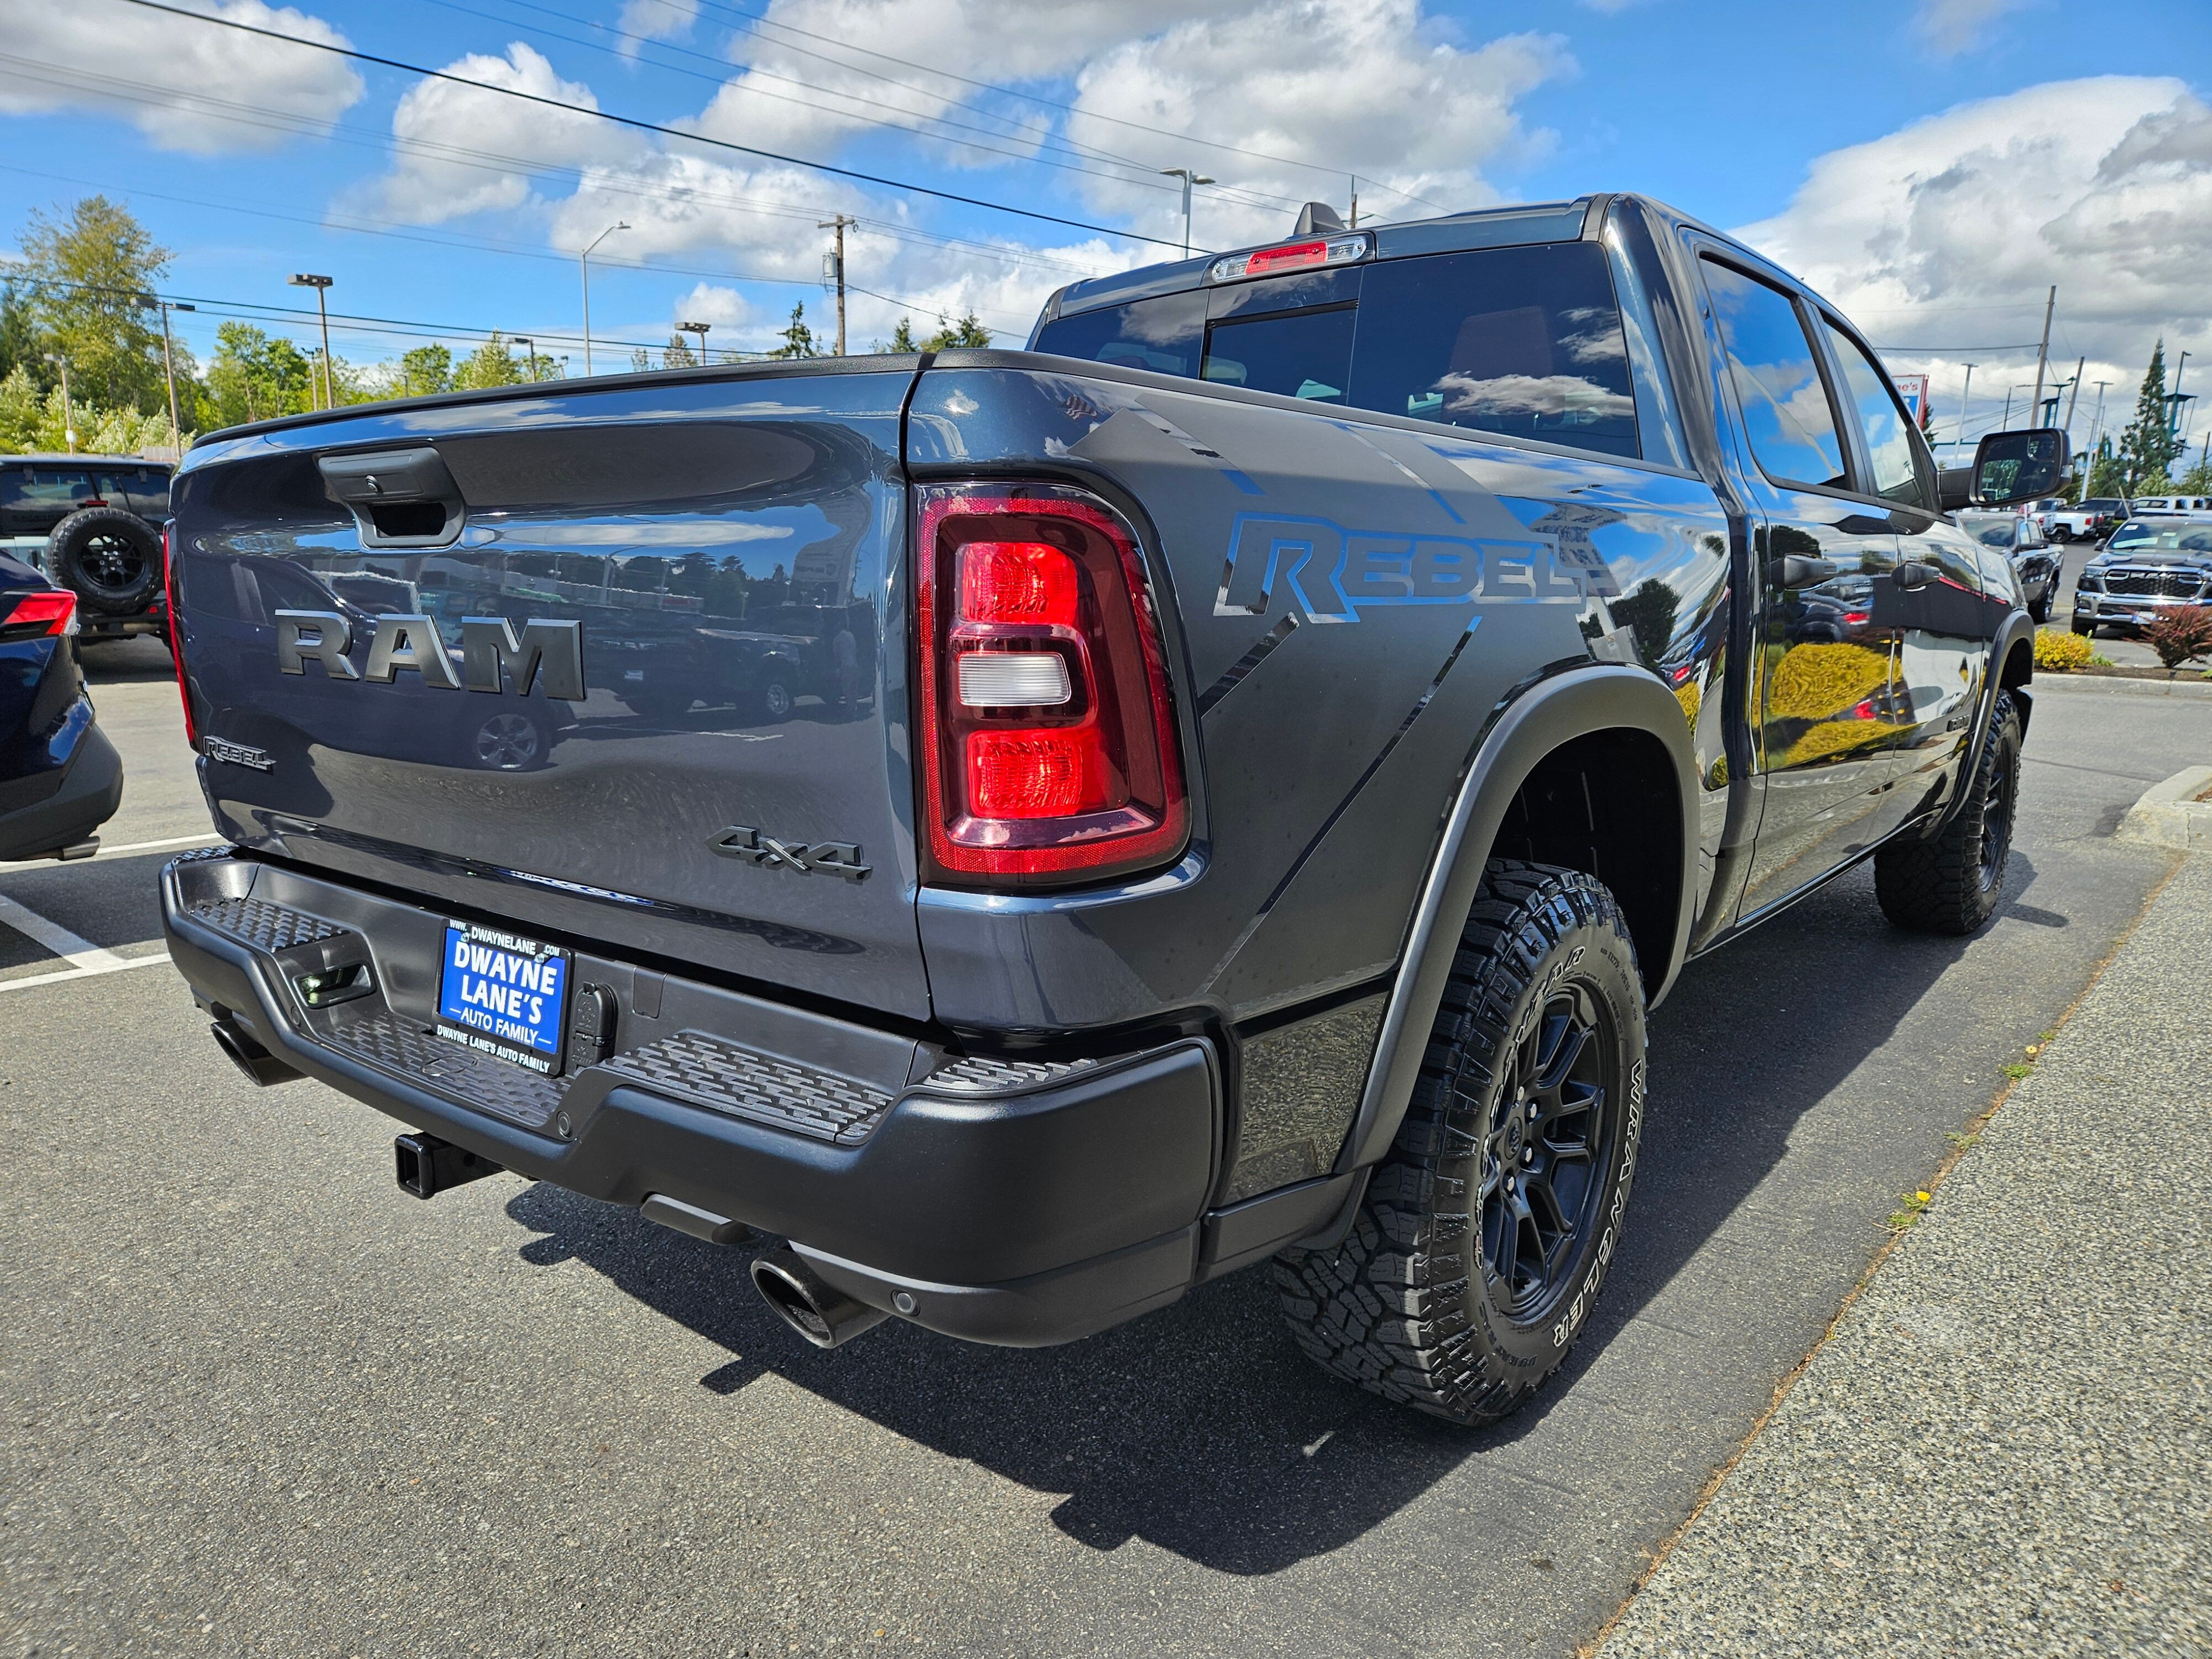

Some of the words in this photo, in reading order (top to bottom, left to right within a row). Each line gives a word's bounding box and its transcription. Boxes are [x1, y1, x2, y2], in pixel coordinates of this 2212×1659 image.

[1213, 512, 1588, 624] REBEL
[275, 609, 587, 700] RAM
[204, 735, 276, 771] REBEL
[450, 919, 467, 931] WWW.
[472, 926, 536, 956] DWAYNELANE
[454, 941, 557, 995] DWAYNE
[461, 974, 543, 1024] LANE'S
[436, 1024, 468, 1045] DWAYNE
[469, 1035, 497, 1055] LANE'S
[496, 1045, 519, 1063] AUTO
[518, 1052, 551, 1074] FAMILY
[460, 1006, 493, 1030] AUTO
[495, 1018, 539, 1045] FAMILY
[1553, 1058, 1642, 1348] WRANGLER
